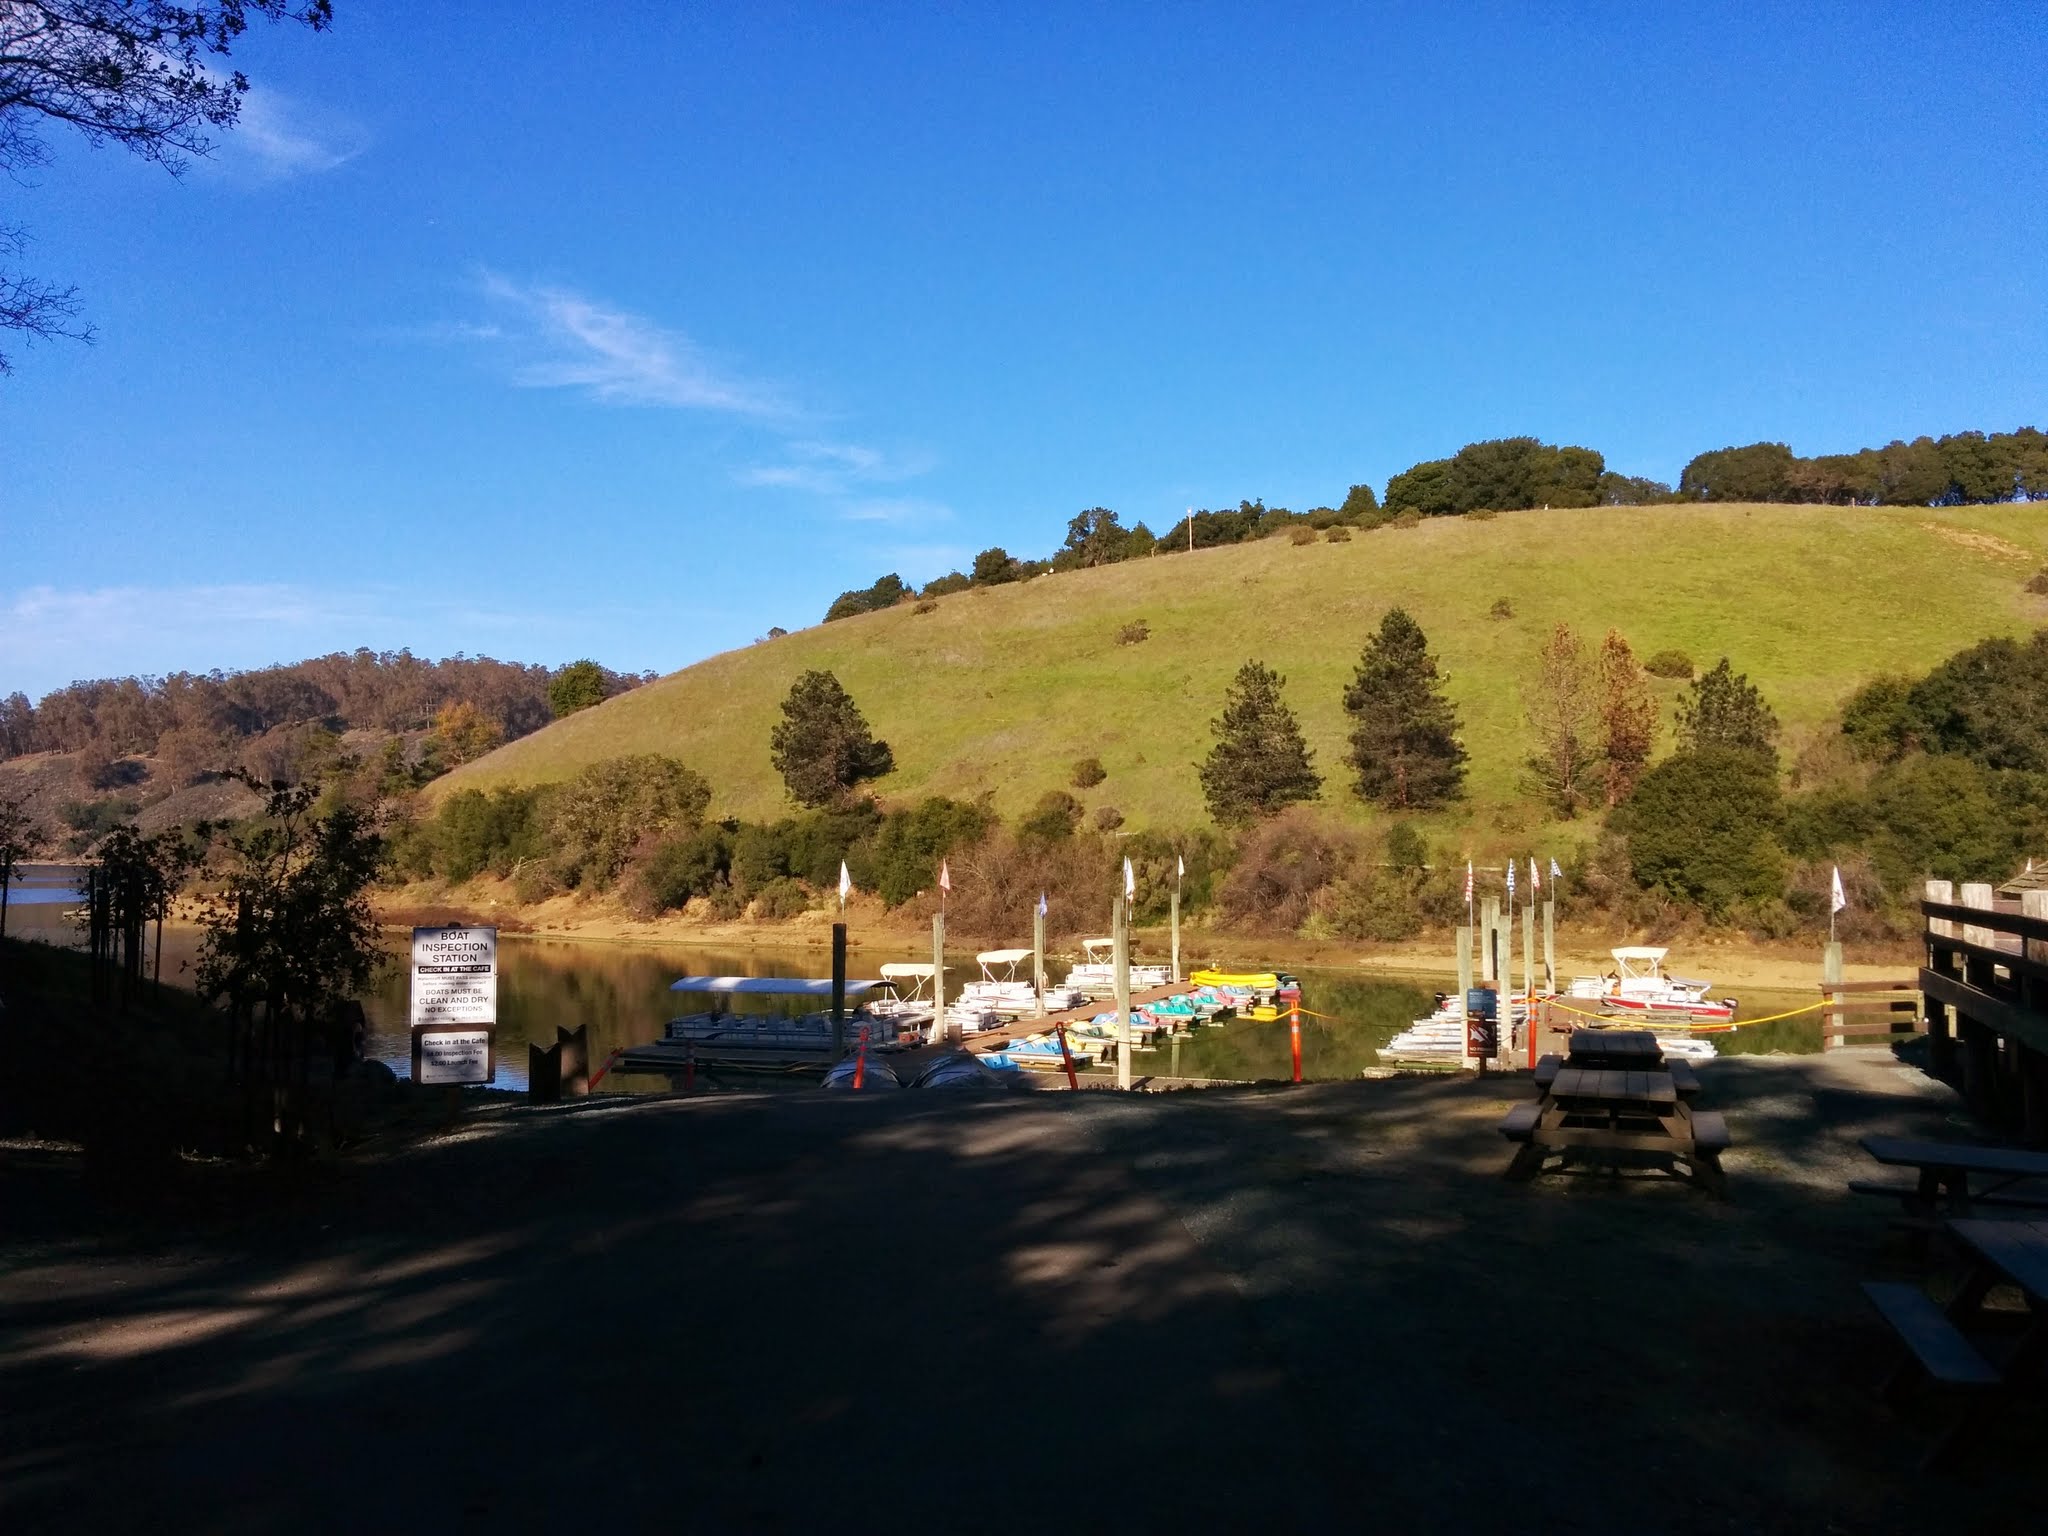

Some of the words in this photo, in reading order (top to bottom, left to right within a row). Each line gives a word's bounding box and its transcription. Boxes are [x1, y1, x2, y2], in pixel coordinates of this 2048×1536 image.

[441, 932, 470, 940] BOAT
[422, 943, 488, 952] INSPECTION
[432, 954, 477, 963] STATION
[419, 997, 448, 1005] CLEAN
[450, 996, 469, 1004] AND
[437, 1005, 483, 1013] EXCEPTIONS
